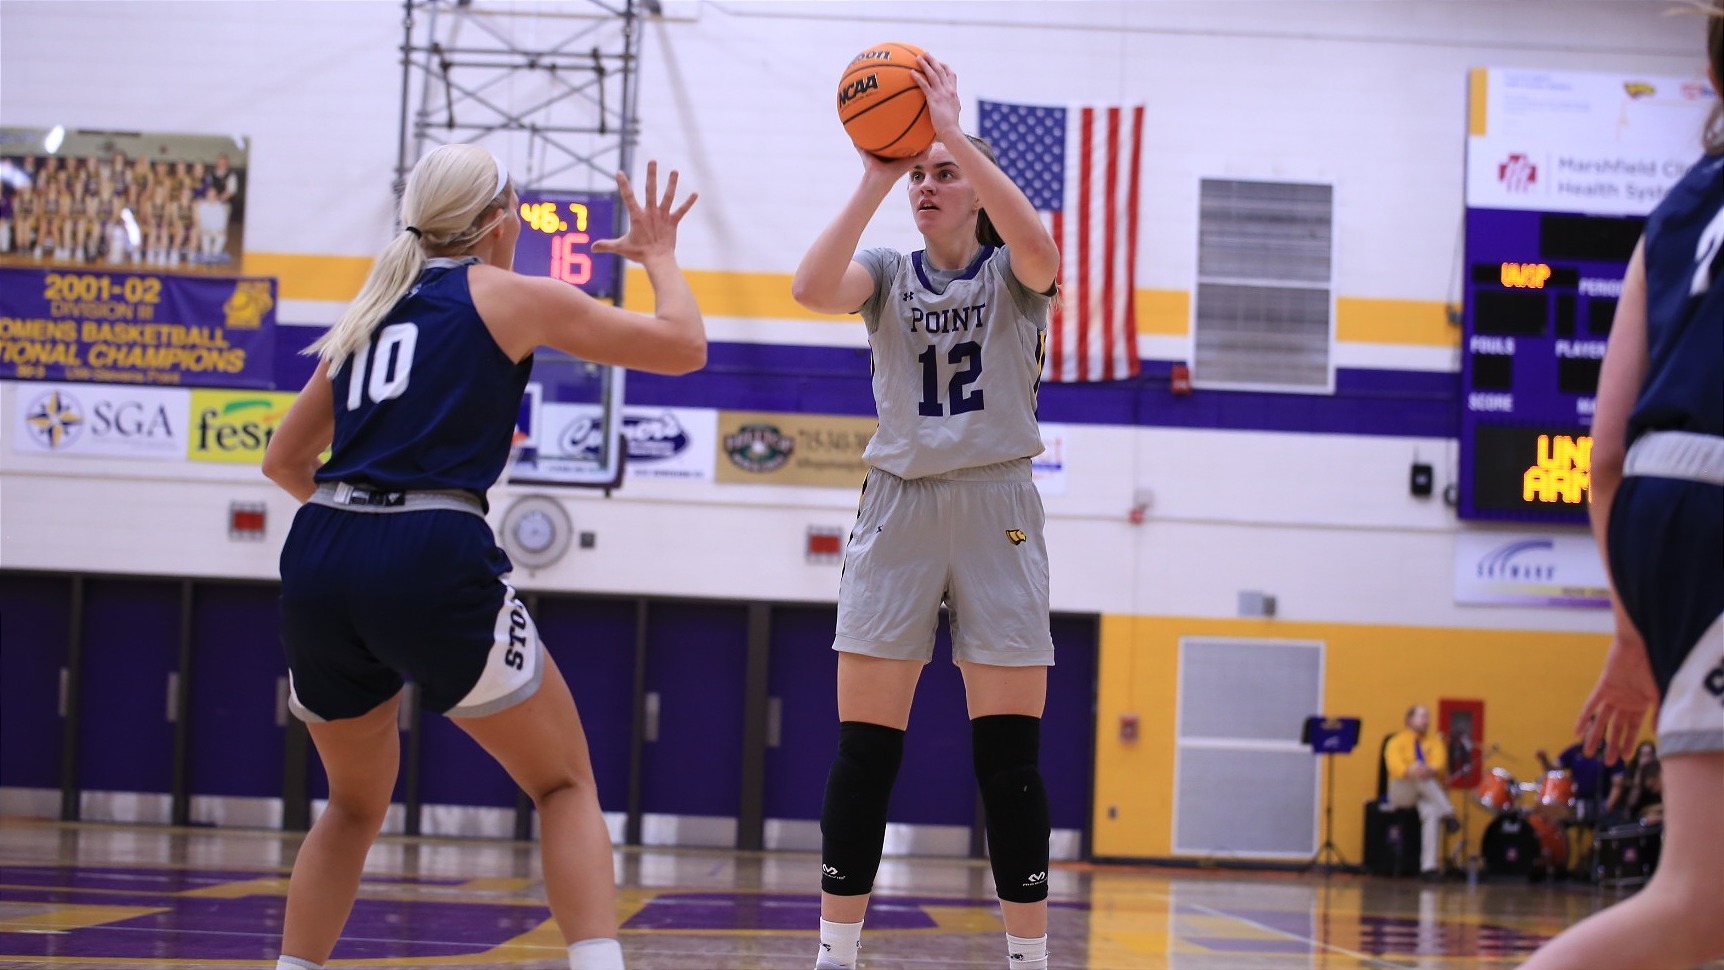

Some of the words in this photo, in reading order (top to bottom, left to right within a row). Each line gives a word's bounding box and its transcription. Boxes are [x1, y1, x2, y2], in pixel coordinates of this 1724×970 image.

[839, 73, 878, 108] NCAA
[1559, 157, 1656, 177] Marshfield
[1558, 182, 1618, 198] Health
[520, 202, 588, 234] 46.7
[551, 232, 592, 285] 16
[44, 274, 162, 303] 2001-02
[1578, 277, 1624, 298] PERIO
[50, 300, 133, 319] DIVISION
[137, 304, 154, 320] III
[911, 303, 985, 334] POINT
[0, 317, 77, 342] OMENS
[81, 321, 230, 349] BASKETBALL
[1470, 335, 1516, 355] FOULS
[0, 340, 81, 367] IONAL
[88, 344, 246, 373] CHAMPIONS
[347, 322, 419, 411] 10
[918, 341, 985, 417] 12
[1468, 393, 1513, 412] SCORE
[91, 401, 173, 438] SGA
[505, 605, 526, 671] STO
